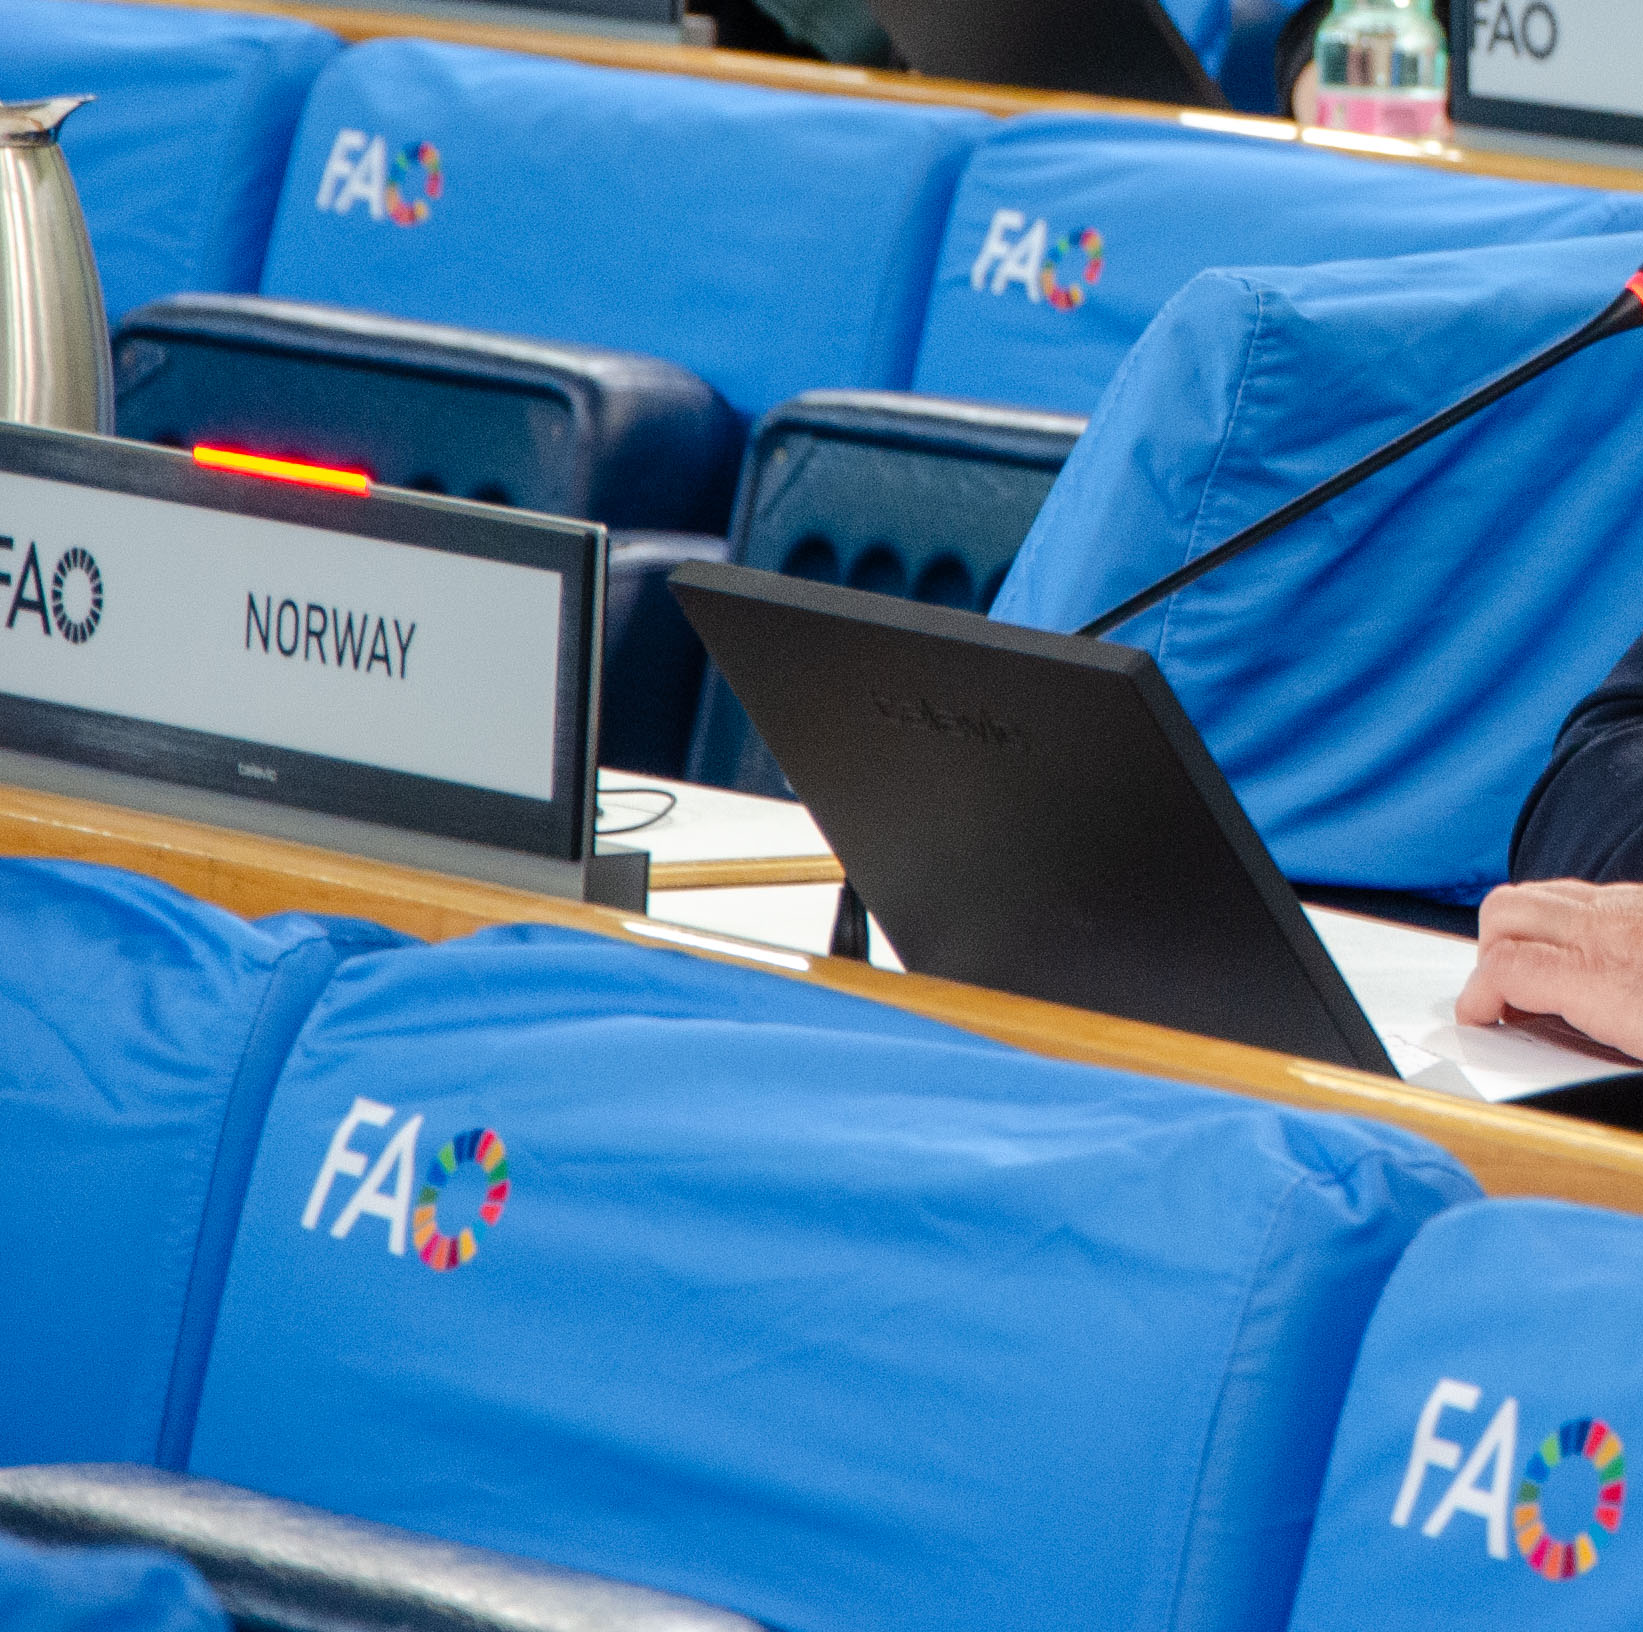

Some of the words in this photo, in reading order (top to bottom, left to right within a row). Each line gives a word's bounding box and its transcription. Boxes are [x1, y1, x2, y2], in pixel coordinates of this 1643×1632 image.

[316, 128, 444, 228] FAO
[971, 209, 1106, 311] FAO
[244, 590, 418, 681] NORWAY
[300, 1095, 512, 1274] FAO
[1390, 1377, 1627, 1582] FAO
